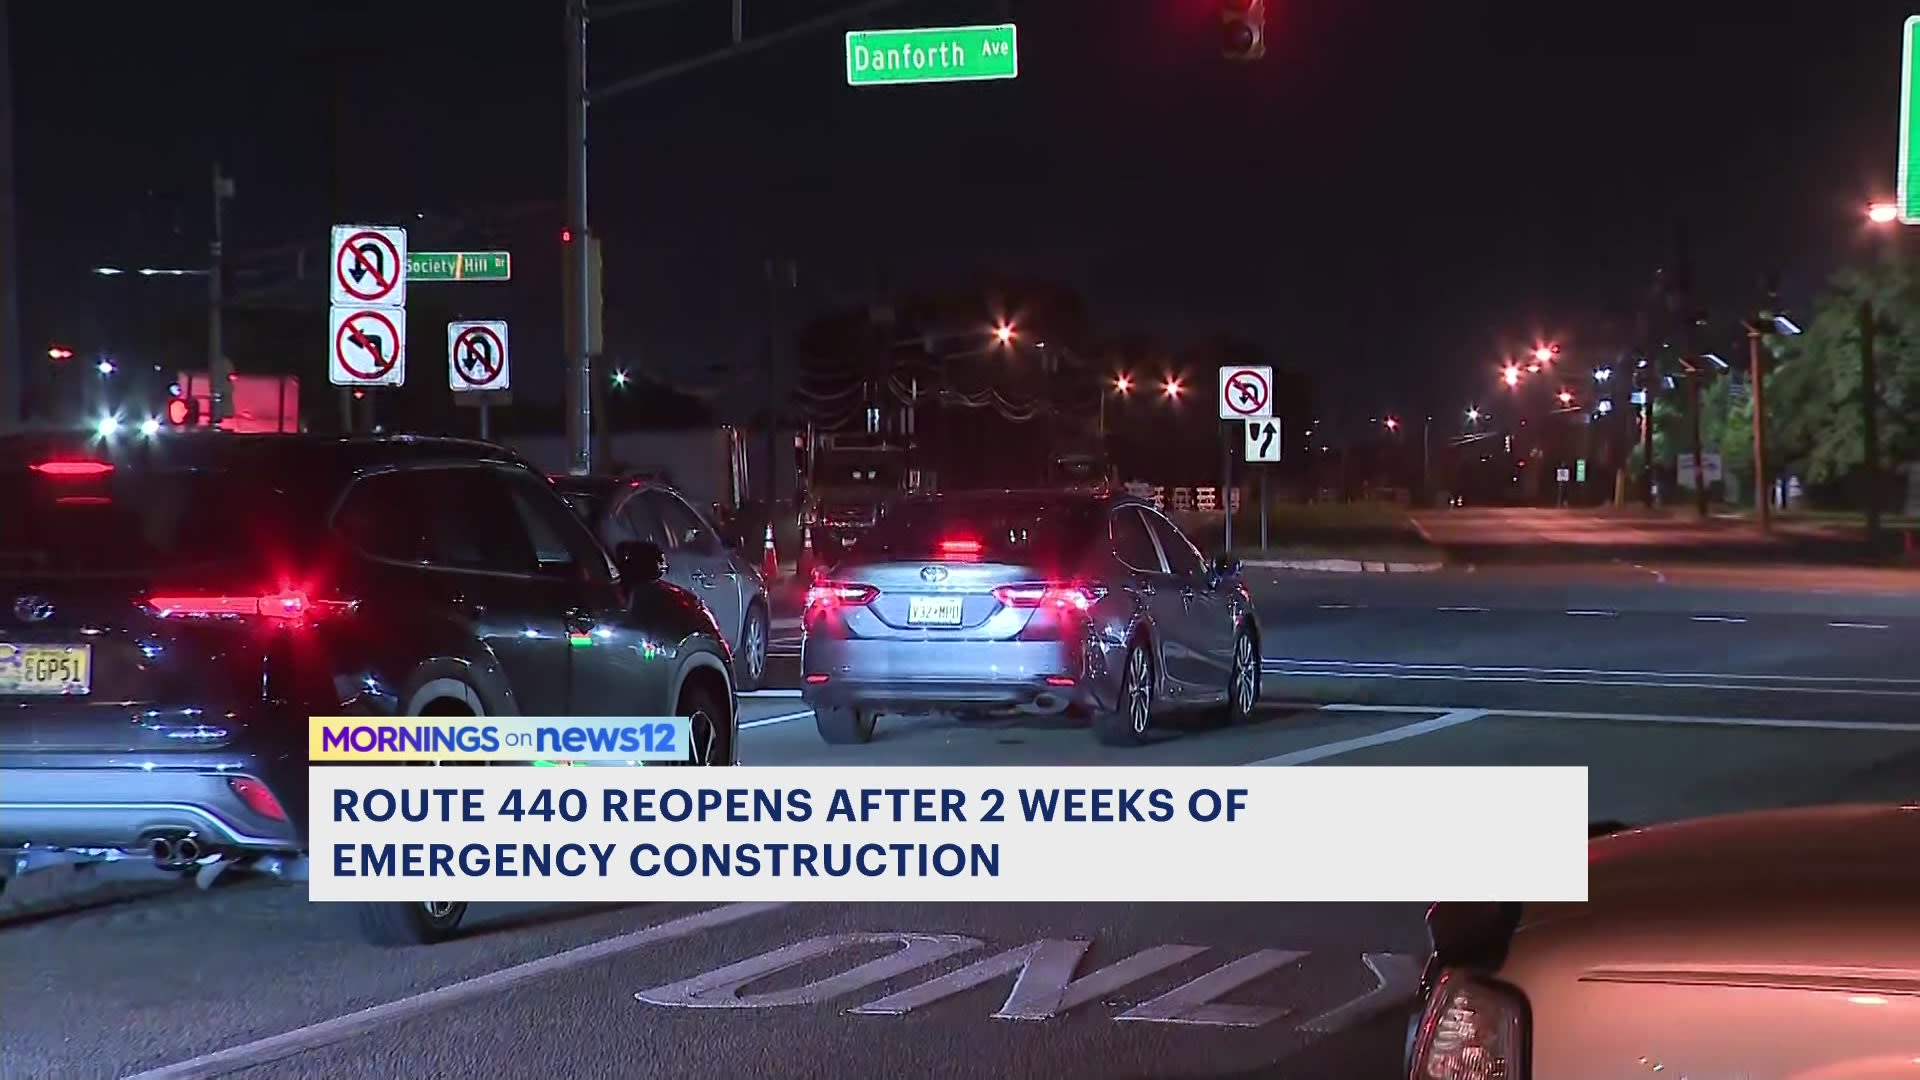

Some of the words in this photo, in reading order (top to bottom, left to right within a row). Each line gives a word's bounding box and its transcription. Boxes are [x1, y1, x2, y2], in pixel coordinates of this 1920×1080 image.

[855, 41, 965, 71] Danforth
[982, 39, 1009, 56] Ave
[407, 258, 455, 276] Society
[464, 258, 488, 272] Hill
